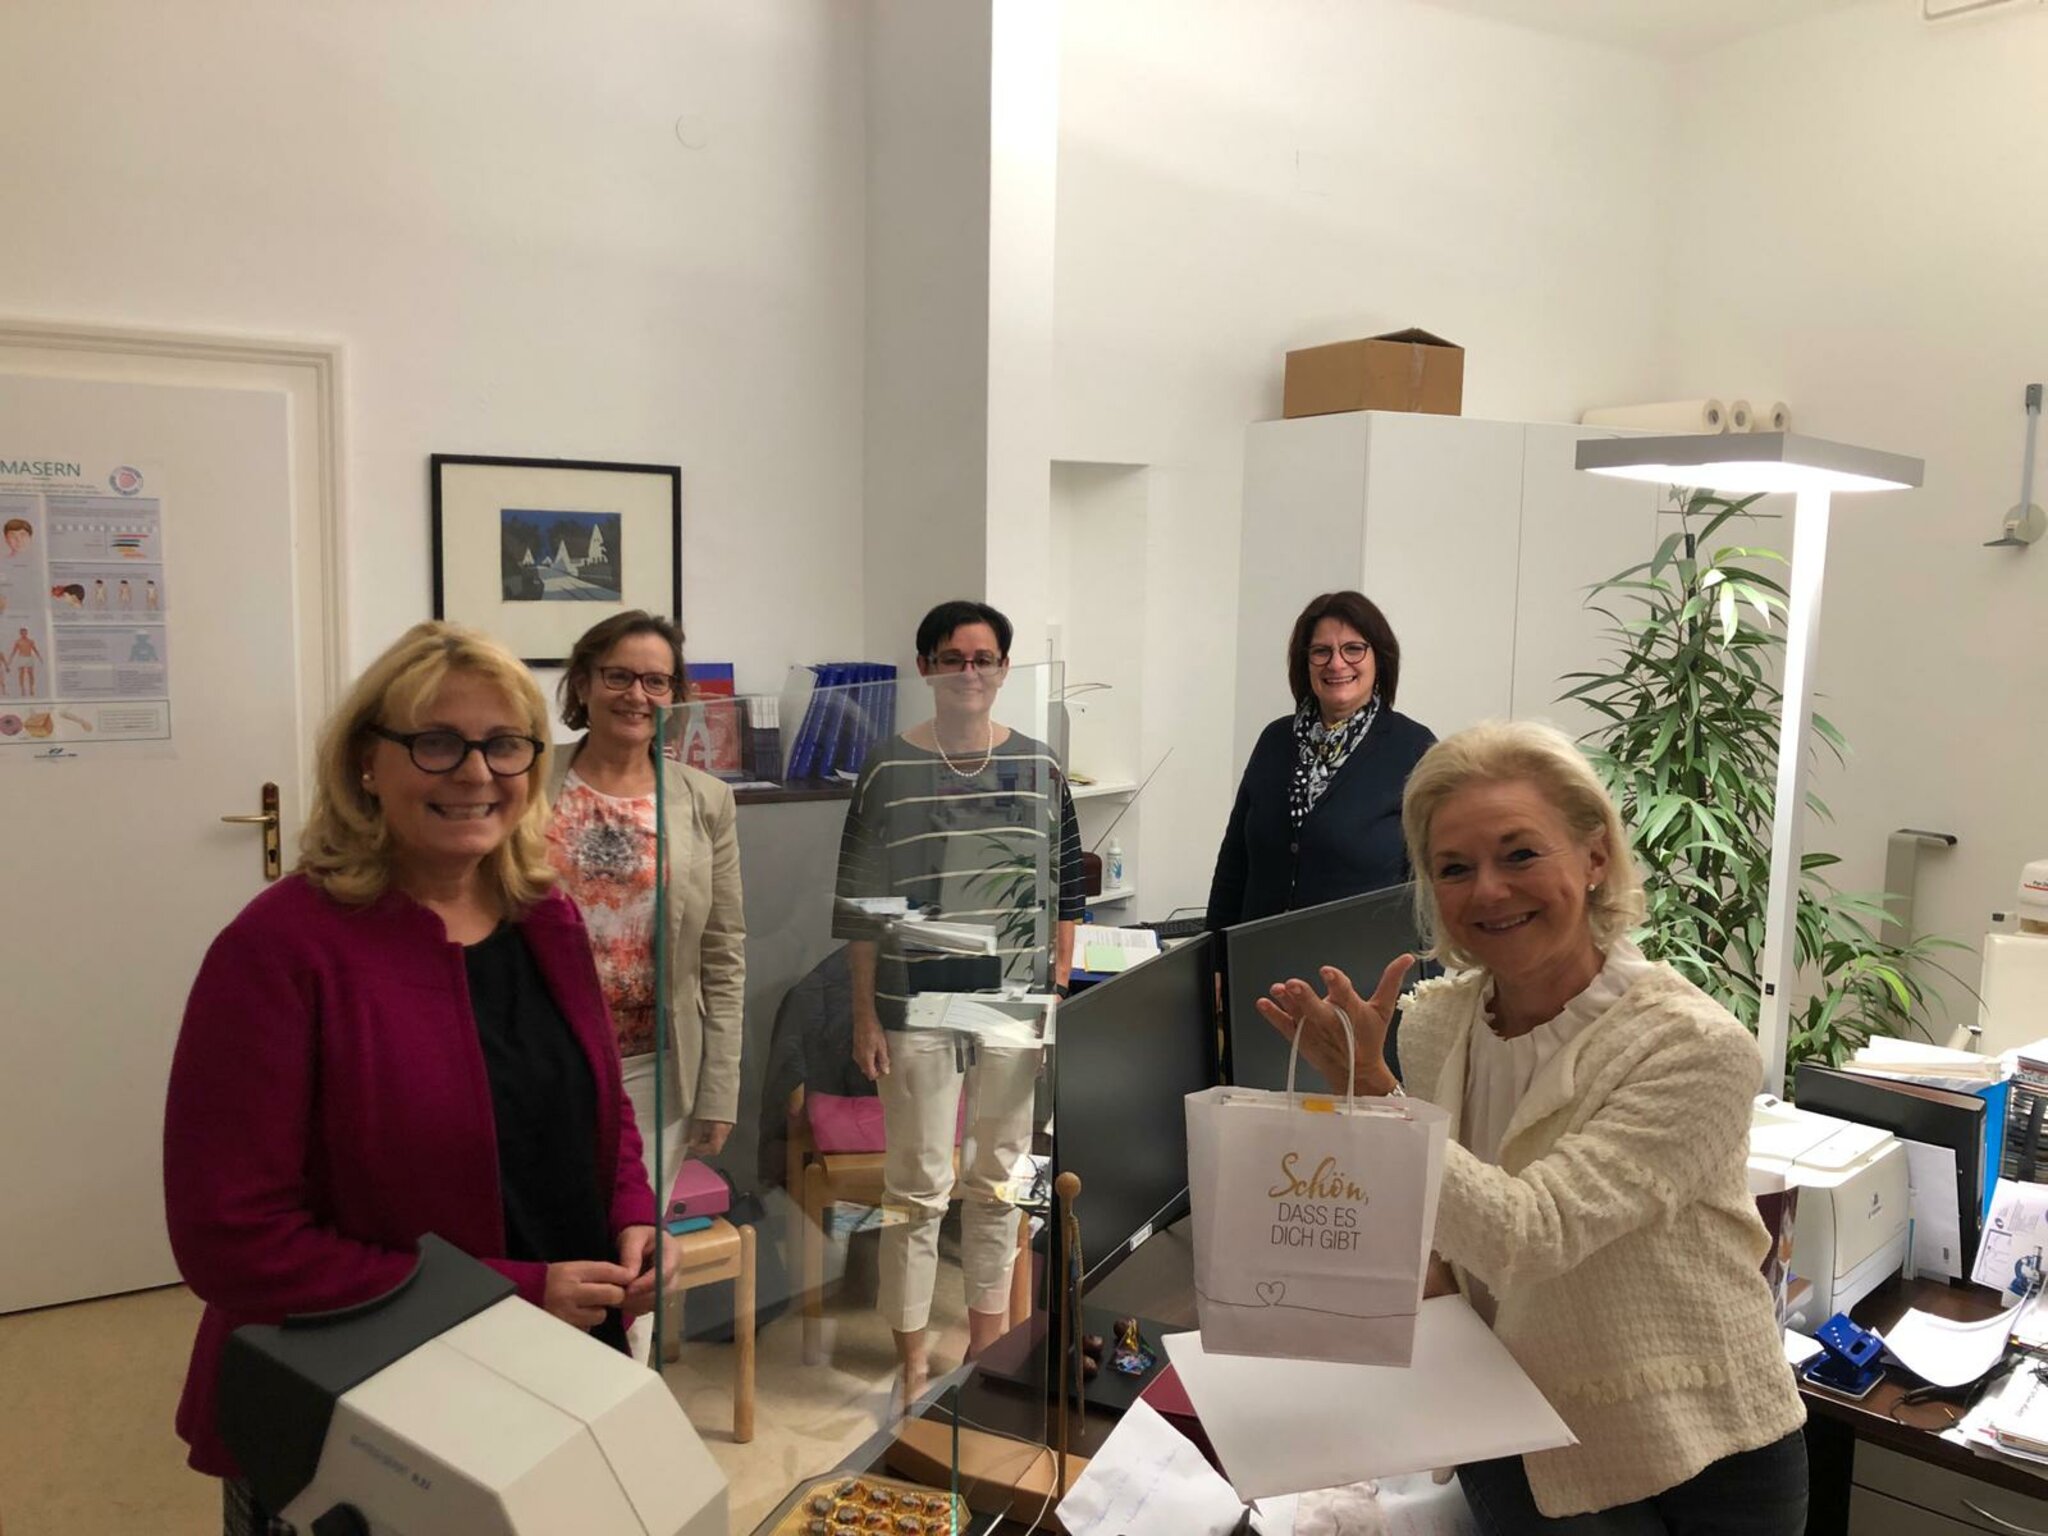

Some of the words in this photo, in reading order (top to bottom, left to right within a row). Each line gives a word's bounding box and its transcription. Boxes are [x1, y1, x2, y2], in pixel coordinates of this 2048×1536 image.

[0, 460, 81, 477] MASERN
[1268, 1152, 1369, 1205] Schön,
[1278, 1202, 1328, 1226] DASS
[1334, 1207, 1357, 1228] ES
[1271, 1224, 1314, 1247] DICH
[1320, 1229, 1361, 1250] GIBT
